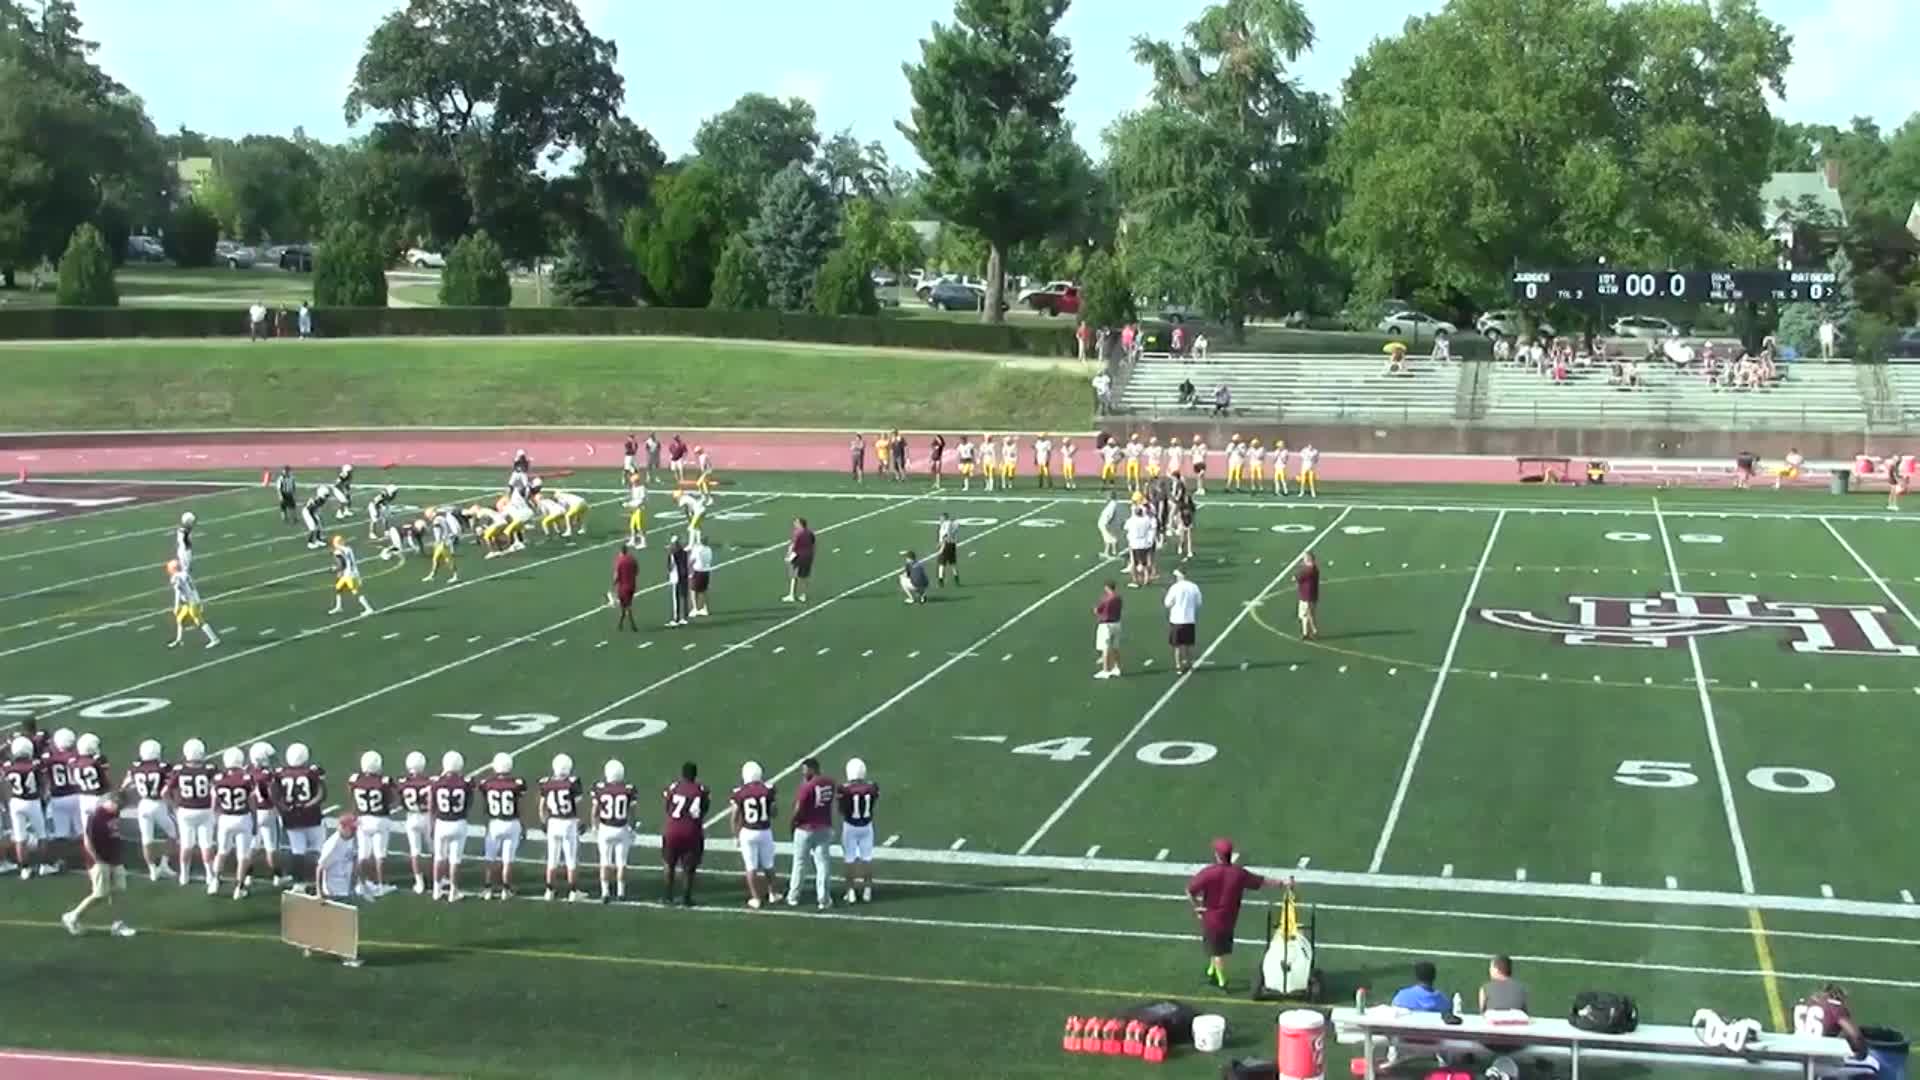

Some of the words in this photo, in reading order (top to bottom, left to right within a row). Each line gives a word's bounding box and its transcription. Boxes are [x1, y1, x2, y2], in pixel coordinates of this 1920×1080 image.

[1790, 272, 1836, 283] RAIDERS
[1525, 283, 1537, 299] 0
[1810, 283, 1822, 299] 0
[8, 771, 37, 795] 34
[134, 772, 161, 796] 67
[281, 775, 311, 802] 73
[218, 788, 247, 810] 32
[354, 788, 383, 812] 52
[436, 788, 465, 813] 63
[487, 790, 514, 816] 66
[547, 790, 573, 815] 45
[600, 794, 627, 819] 30
[671, 794, 700, 819] 74
[743, 796, 768, 823] 61
[852, 794, 871, 819] 11
